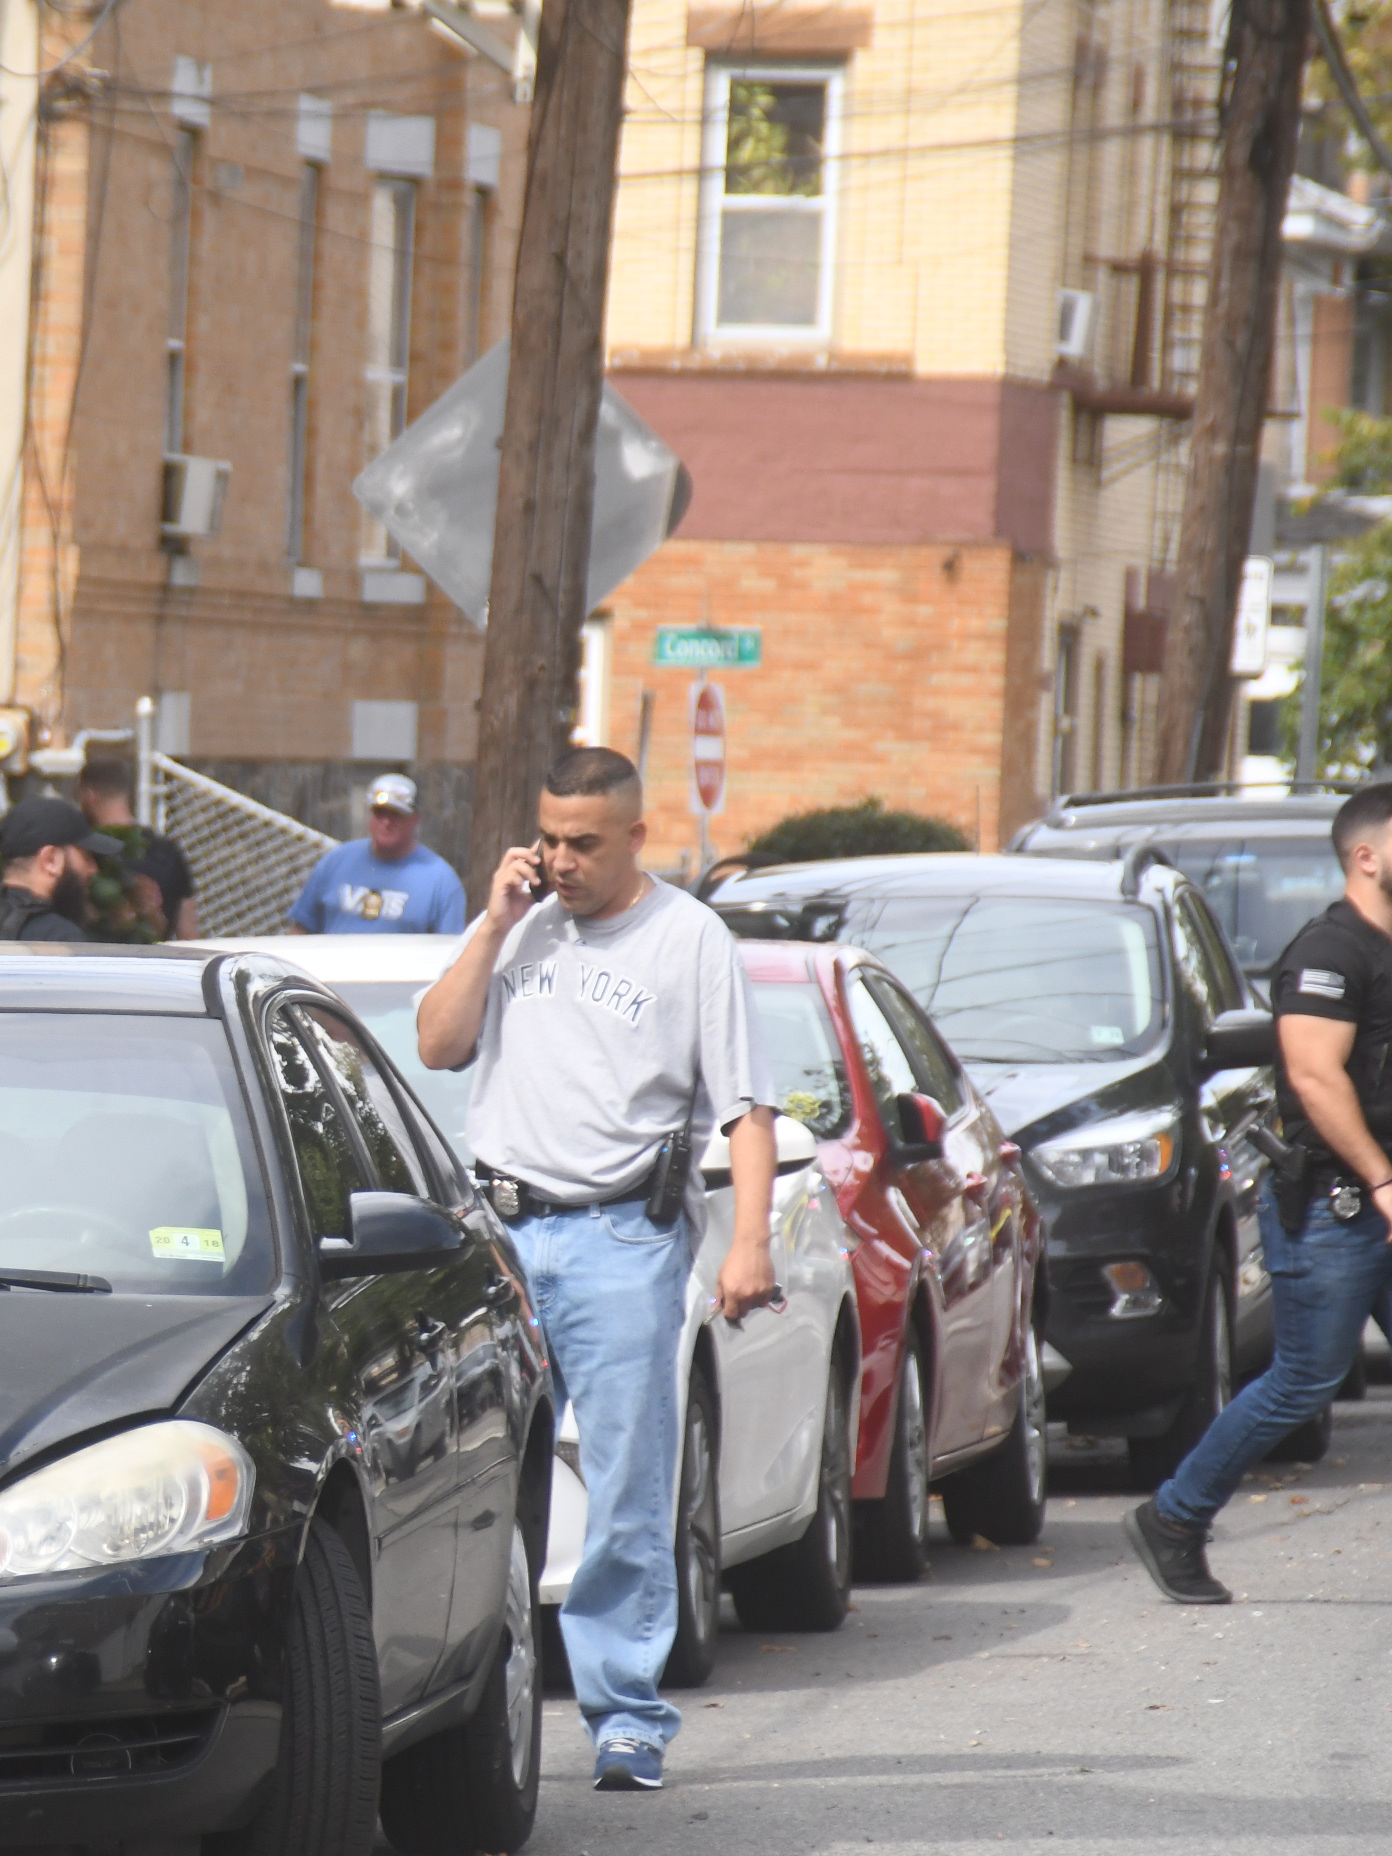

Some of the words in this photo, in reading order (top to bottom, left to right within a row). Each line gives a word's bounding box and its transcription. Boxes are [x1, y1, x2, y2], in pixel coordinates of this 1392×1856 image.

[662, 632, 739, 660] Concord
[501, 960, 559, 1000] NEW
[578, 962, 657, 1025] YORK
[181, 1235, 190, 1247] 4
